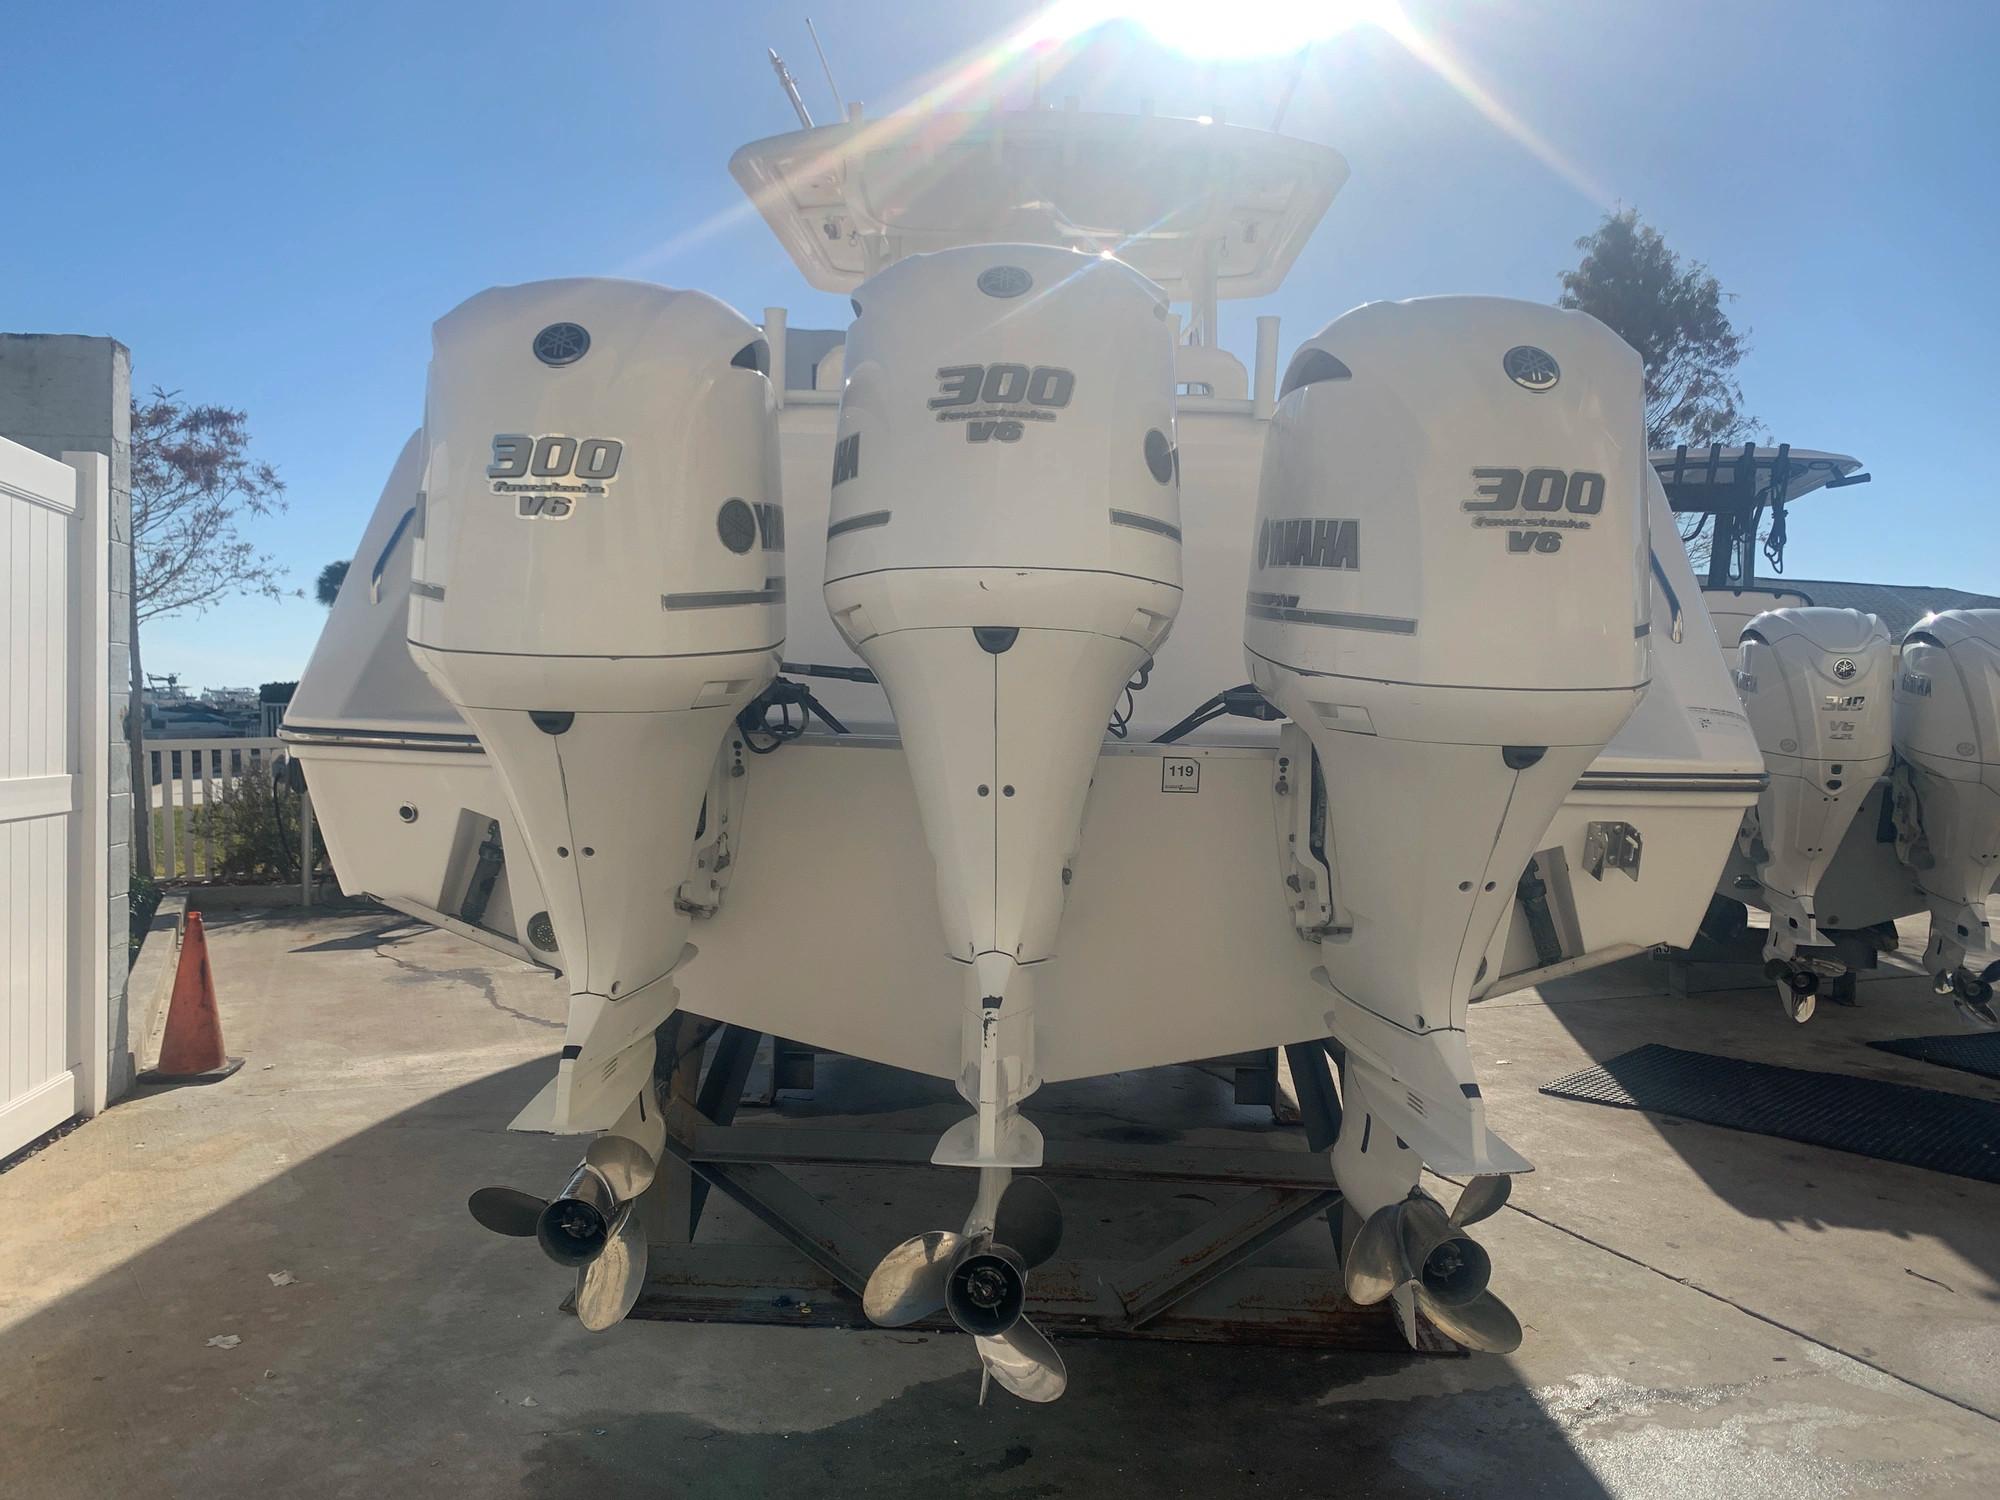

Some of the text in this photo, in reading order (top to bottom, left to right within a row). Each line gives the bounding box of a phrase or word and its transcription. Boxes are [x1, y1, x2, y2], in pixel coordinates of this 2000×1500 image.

[928, 363, 1075, 408] 300
[967, 421, 1024, 441] V6
[486, 435, 624, 479] 300
[1463, 467, 1606, 515] 300
[519, 495, 573, 517] V6
[1508, 530, 1563, 553] V6
[1169, 765, 1194, 777] 119
